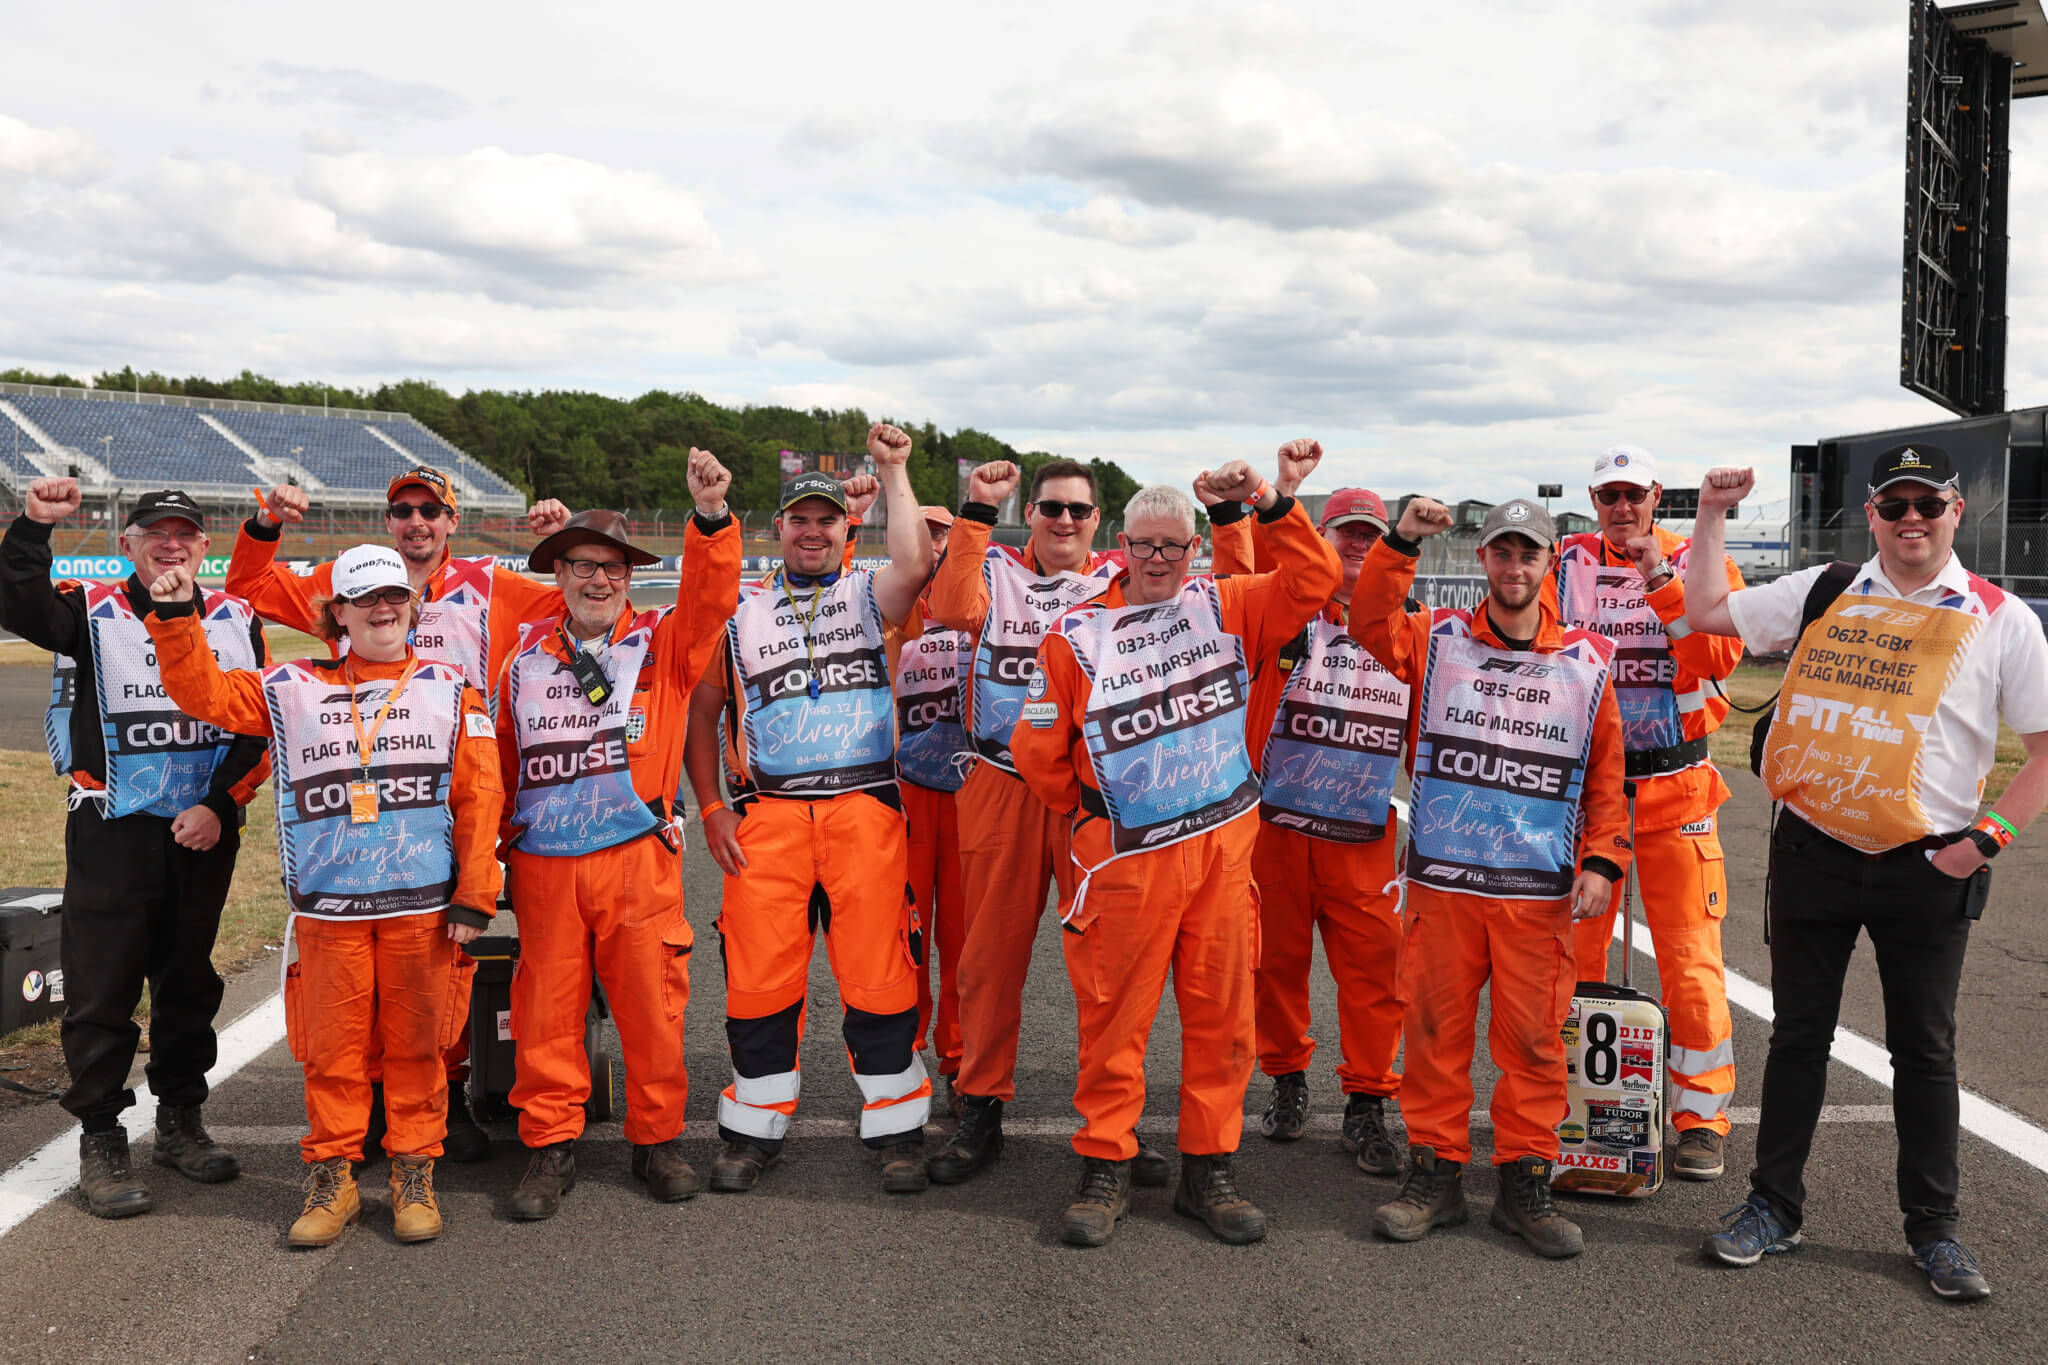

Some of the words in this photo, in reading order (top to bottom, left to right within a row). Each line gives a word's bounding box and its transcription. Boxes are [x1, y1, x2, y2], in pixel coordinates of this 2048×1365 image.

[52, 559, 121, 575] amco
[850, 557, 893, 572] crypto.co
[1440, 580, 1484, 610] crypto
[1003, 620, 1040, 636] FLAG
[1116, 618, 1192, 655] 0323-GBR
[1599, 621, 1668, 637] MARSHA
[1826, 625, 1913, 652] 0622-GBR
[759, 637, 799, 659] FLAG
[903, 667, 937, 685] FLAG
[1102, 668, 1143, 694] FLAG
[1147, 640, 1220, 680] MARSHAL
[1807, 648, 1868, 670] DEPUTY
[1869, 658, 1918, 679] CHIEF
[1297, 677, 1334, 695] FLAG
[1338, 683, 1403, 706] MARSHAL
[1798, 663, 1833, 682] FLAG
[1835, 671, 1914, 696] MARSHAL
[528, 716, 558, 732] FLAG
[1112, 678, 1235, 742] COURSE
[1445, 706, 1485, 727] FLAG
[1490, 715, 1569, 743] MARSHAL
[1787, 693, 1854, 733] PIT
[1291, 714, 1400, 751] COURSE
[302, 742, 340, 764] FLAG
[347, 734, 436, 755] MRSHAL
[1438, 749, 1562, 794] COURSE
[304, 775, 432, 814] CORSE
[1681, 824, 1706, 832] KNAF
[1584, 1012, 1618, 1086] 8
[1622, 1080, 1650, 1090] Marlboro
[1604, 1108, 1643, 1120] TUDOR
[1531, 1165, 1545, 1175] CAT
